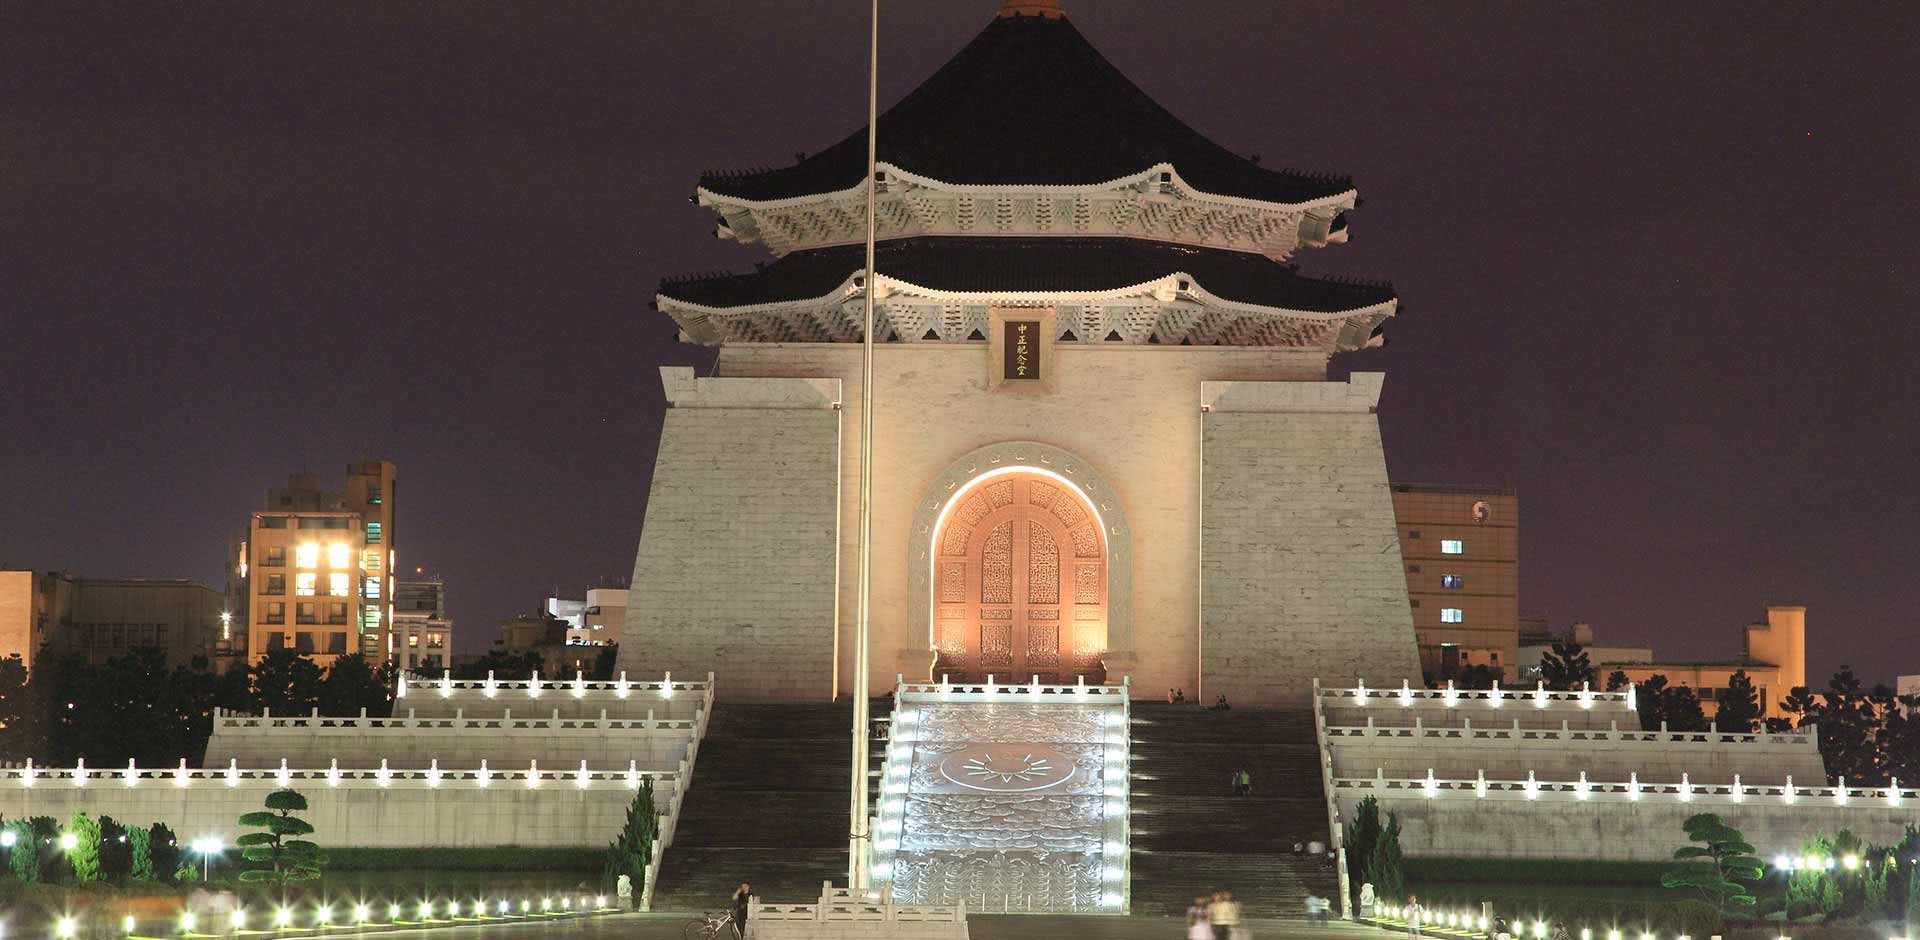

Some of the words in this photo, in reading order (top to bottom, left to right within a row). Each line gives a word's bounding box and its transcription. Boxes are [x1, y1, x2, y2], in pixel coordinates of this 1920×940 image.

[1017, 323, 1028, 376] 中正紀念堂
